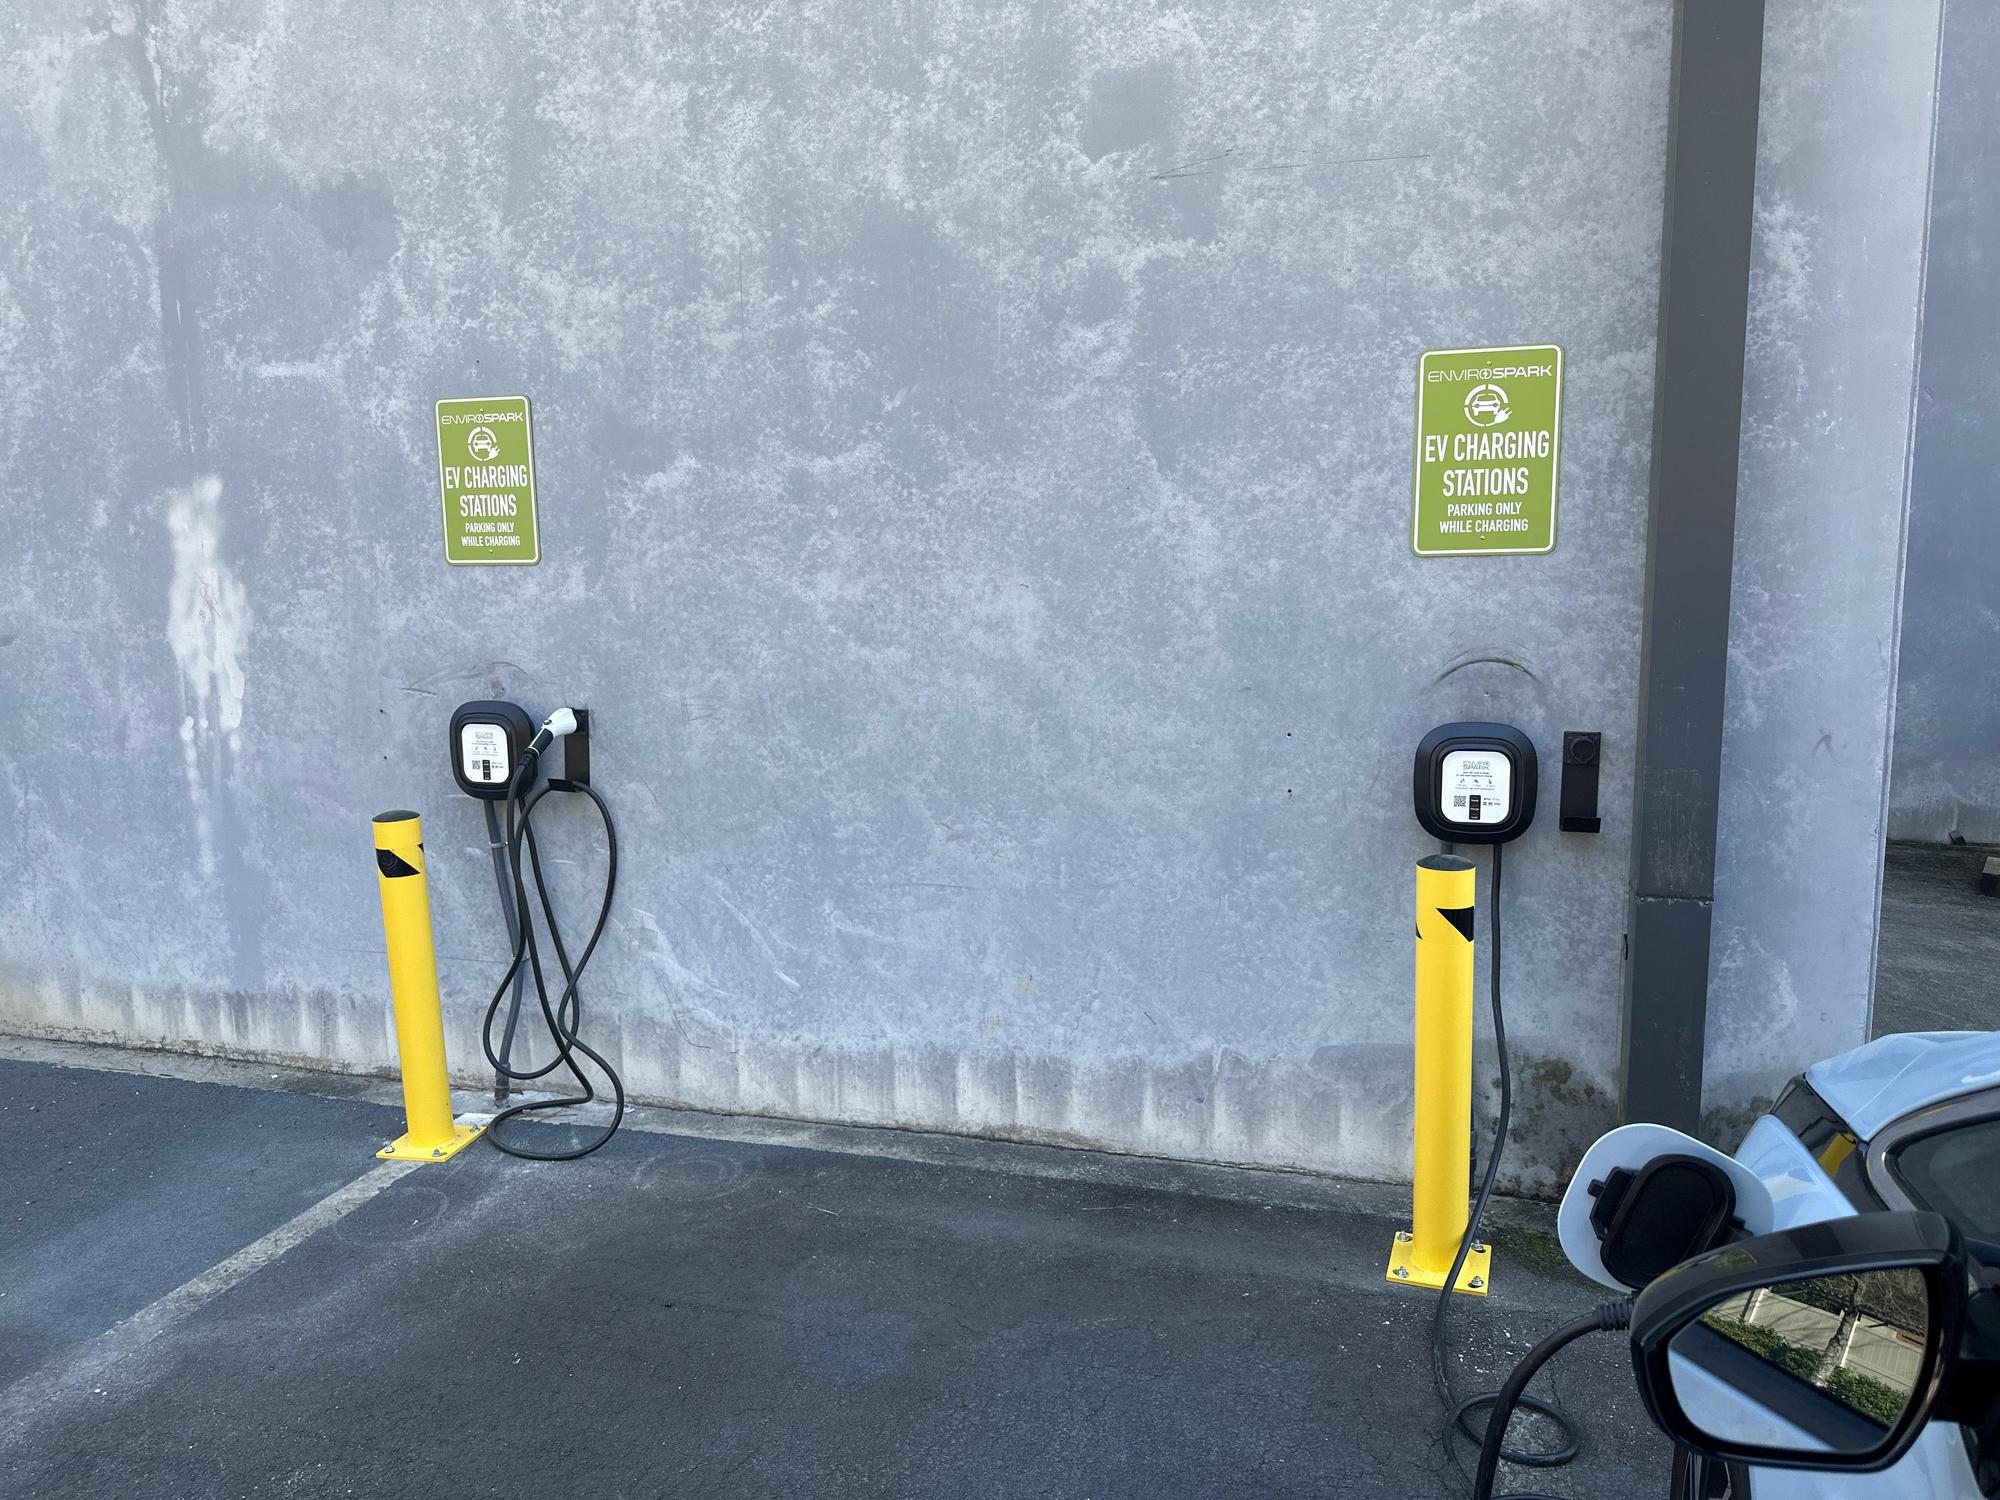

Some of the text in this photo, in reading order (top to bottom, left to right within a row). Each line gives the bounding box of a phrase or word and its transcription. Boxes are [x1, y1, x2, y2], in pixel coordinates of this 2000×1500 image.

[1425, 430, 1550, 462] EV CHARGING
[446, 465, 528, 488] EV CHARGING
[1442, 467, 1529, 497] STATIONS
[460, 494, 517, 517] STATIONS
[1447, 502, 1522, 516] PARKING ONLY
[465, 522, 514, 532] PARKING ONLY
[1440, 519, 1528, 533] WHILE CHARGING
[461, 536, 520, 546] WHILE CHARGING
